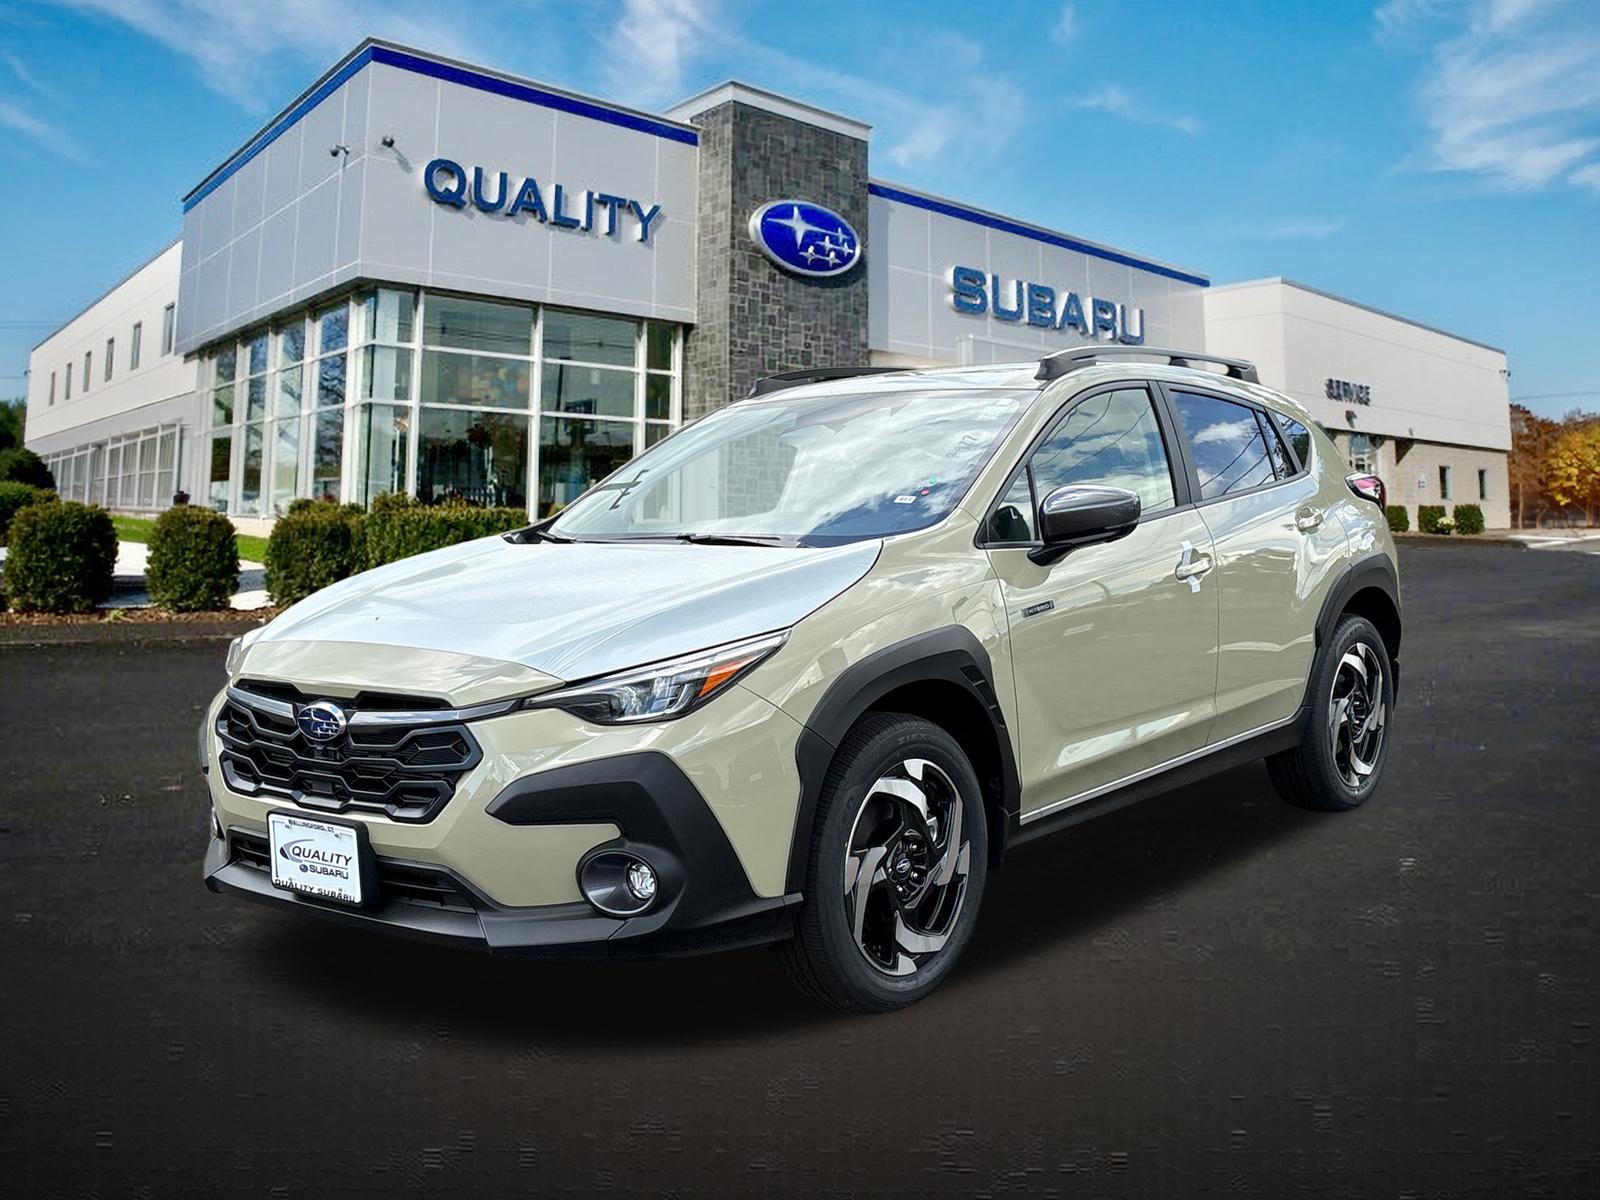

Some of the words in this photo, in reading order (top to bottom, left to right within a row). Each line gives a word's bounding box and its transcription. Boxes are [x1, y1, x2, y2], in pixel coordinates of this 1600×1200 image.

[423, 157, 661, 243] QUALITY
[949, 264, 1145, 346] SUBARU
[1325, 378, 1370, 406] SERVICE
[292, 845, 352, 866] QUALITY
[309, 864, 349, 880] SUBARU
[275, 879, 314, 893] QUALITY
[317, 887, 355, 902] SUBARU
